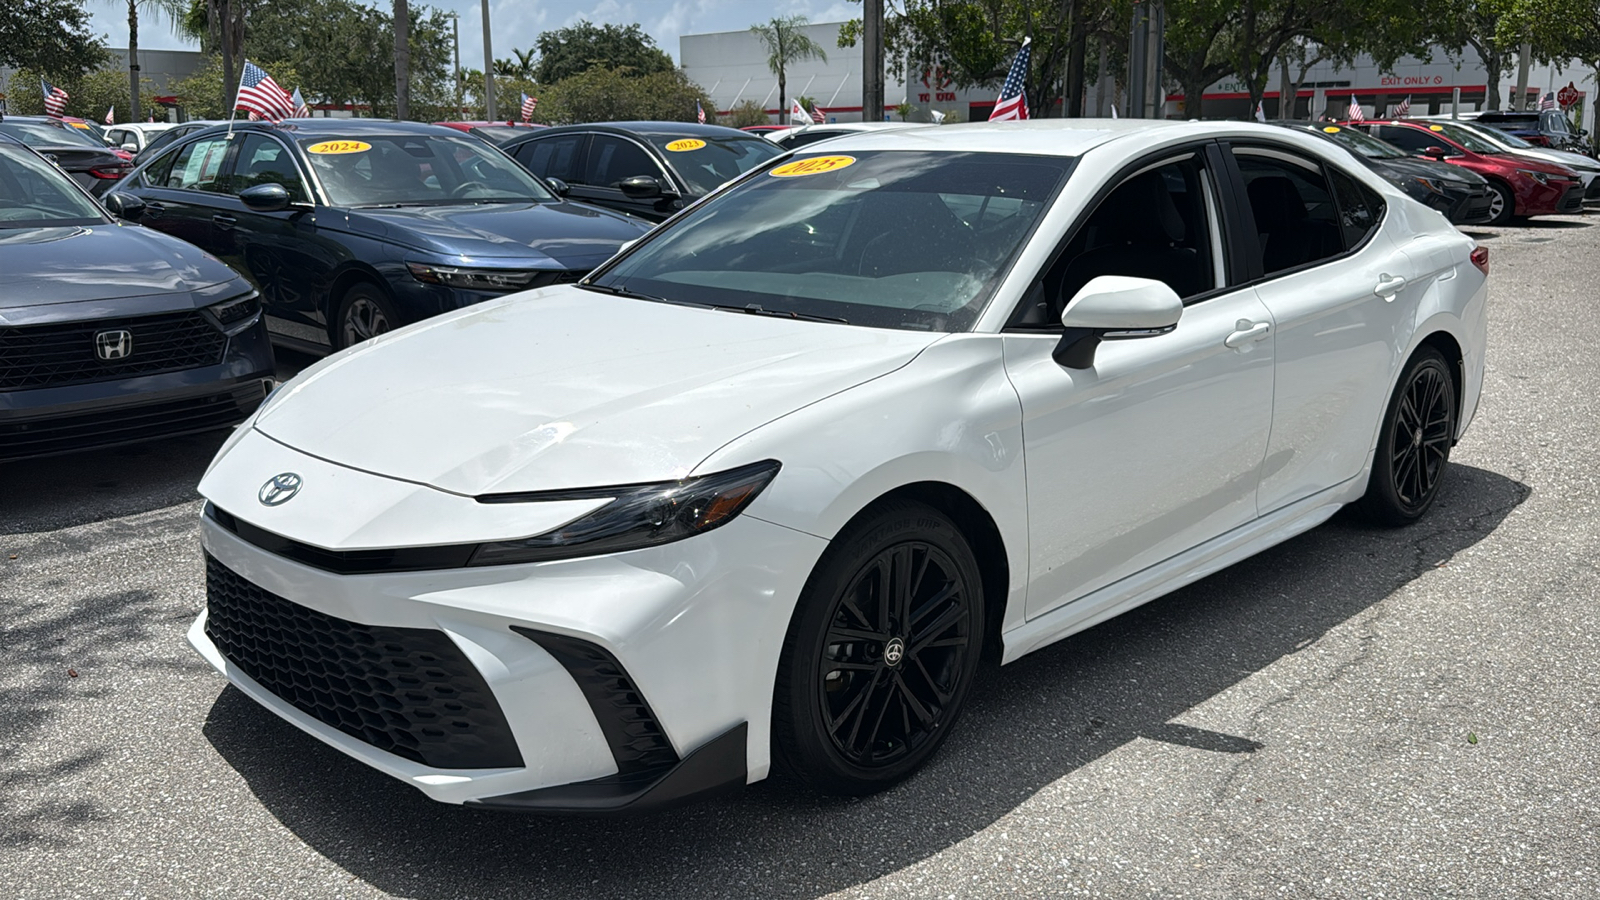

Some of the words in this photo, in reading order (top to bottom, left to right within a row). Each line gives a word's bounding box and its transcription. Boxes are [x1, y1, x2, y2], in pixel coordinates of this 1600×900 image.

[1381, 77, 1401, 85] EXIT
[1404, 76, 1430, 85] ONLY
[918, 92, 956, 102] TOOTA
[320, 143, 360, 152] 2024
[674, 140, 699, 150] 2023
[778, 158, 846, 175] 2025
